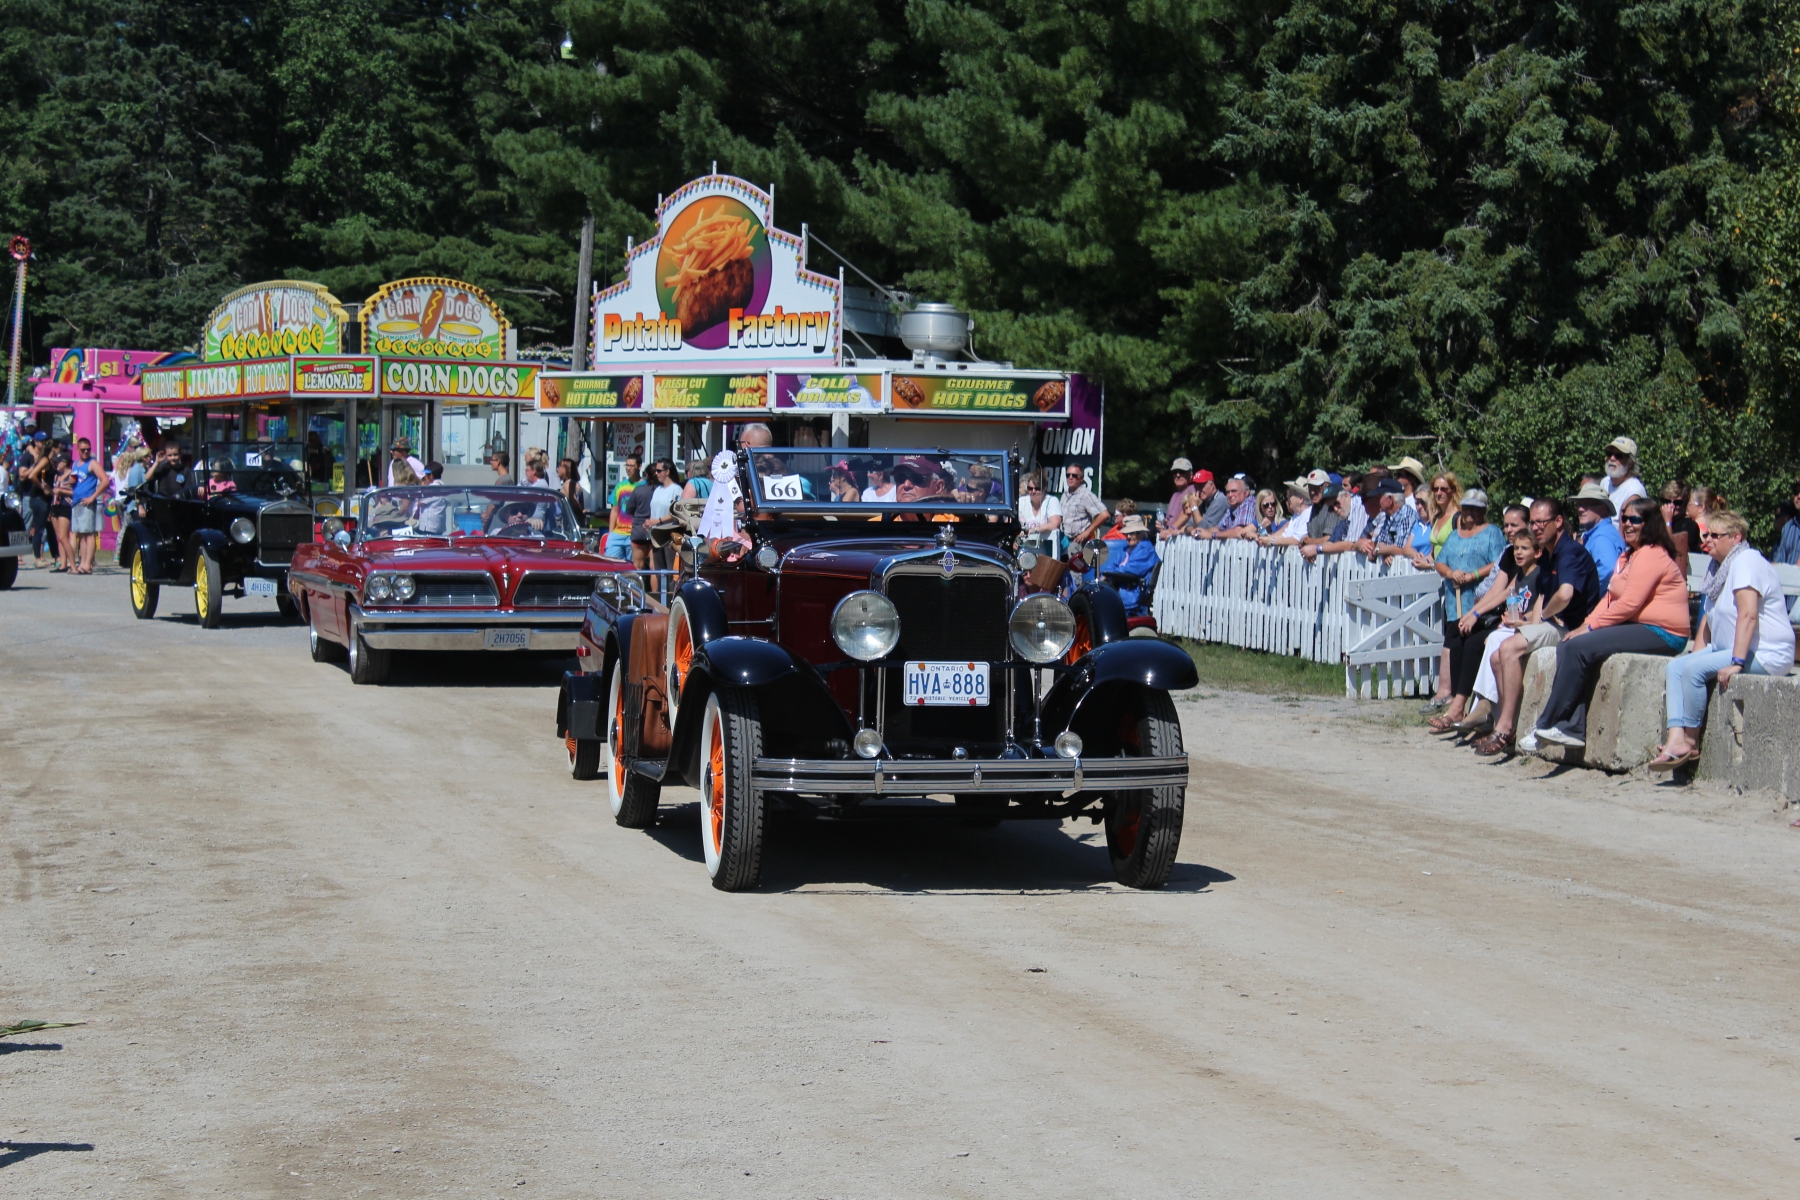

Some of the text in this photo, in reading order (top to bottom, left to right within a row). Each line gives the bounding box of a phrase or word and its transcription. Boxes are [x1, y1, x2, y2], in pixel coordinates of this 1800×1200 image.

[236, 293, 311, 332] CORN DOGS
[386, 296, 482, 323] CORN DOGS
[603, 305, 831, 353] Potato Factory
[224, 326, 322, 355] LEMONADE
[380, 339, 489, 355] LEMONADE
[145, 371, 181, 400] GOURMET
[188, 366, 239, 398] JUMBO
[246, 361, 287, 394] HOT DOGS
[304, 373, 364, 390] LEMONADE
[386, 362, 519, 397] CORN DOGS
[573, 379, 610, 390] GOURMET
[660, 378, 708, 389] FRESH CUT
[729, 377, 758, 389] ONION
[806, 377, 850, 389] COLD
[946, 379, 1013, 391] GOURMET
[566, 392, 618, 407] HOT DOGS
[669, 393, 700, 407] FRIES
[723, 393, 760, 407] RINGS
[796, 392, 861, 403] DRINKS
[932, 392, 1027, 408] HOT DOGS
[615, 422, 634, 433] JUMBO
[618, 434, 630, 445] HOT
[1042, 427, 1096, 455] ONION
[616, 446, 632, 457] DOGS
[1046, 466, 1094, 493] RINS
[770, 480, 797, 498] 66
[493, 633, 526, 644] 2H7056
[909, 672, 985, 695] HVA 888
